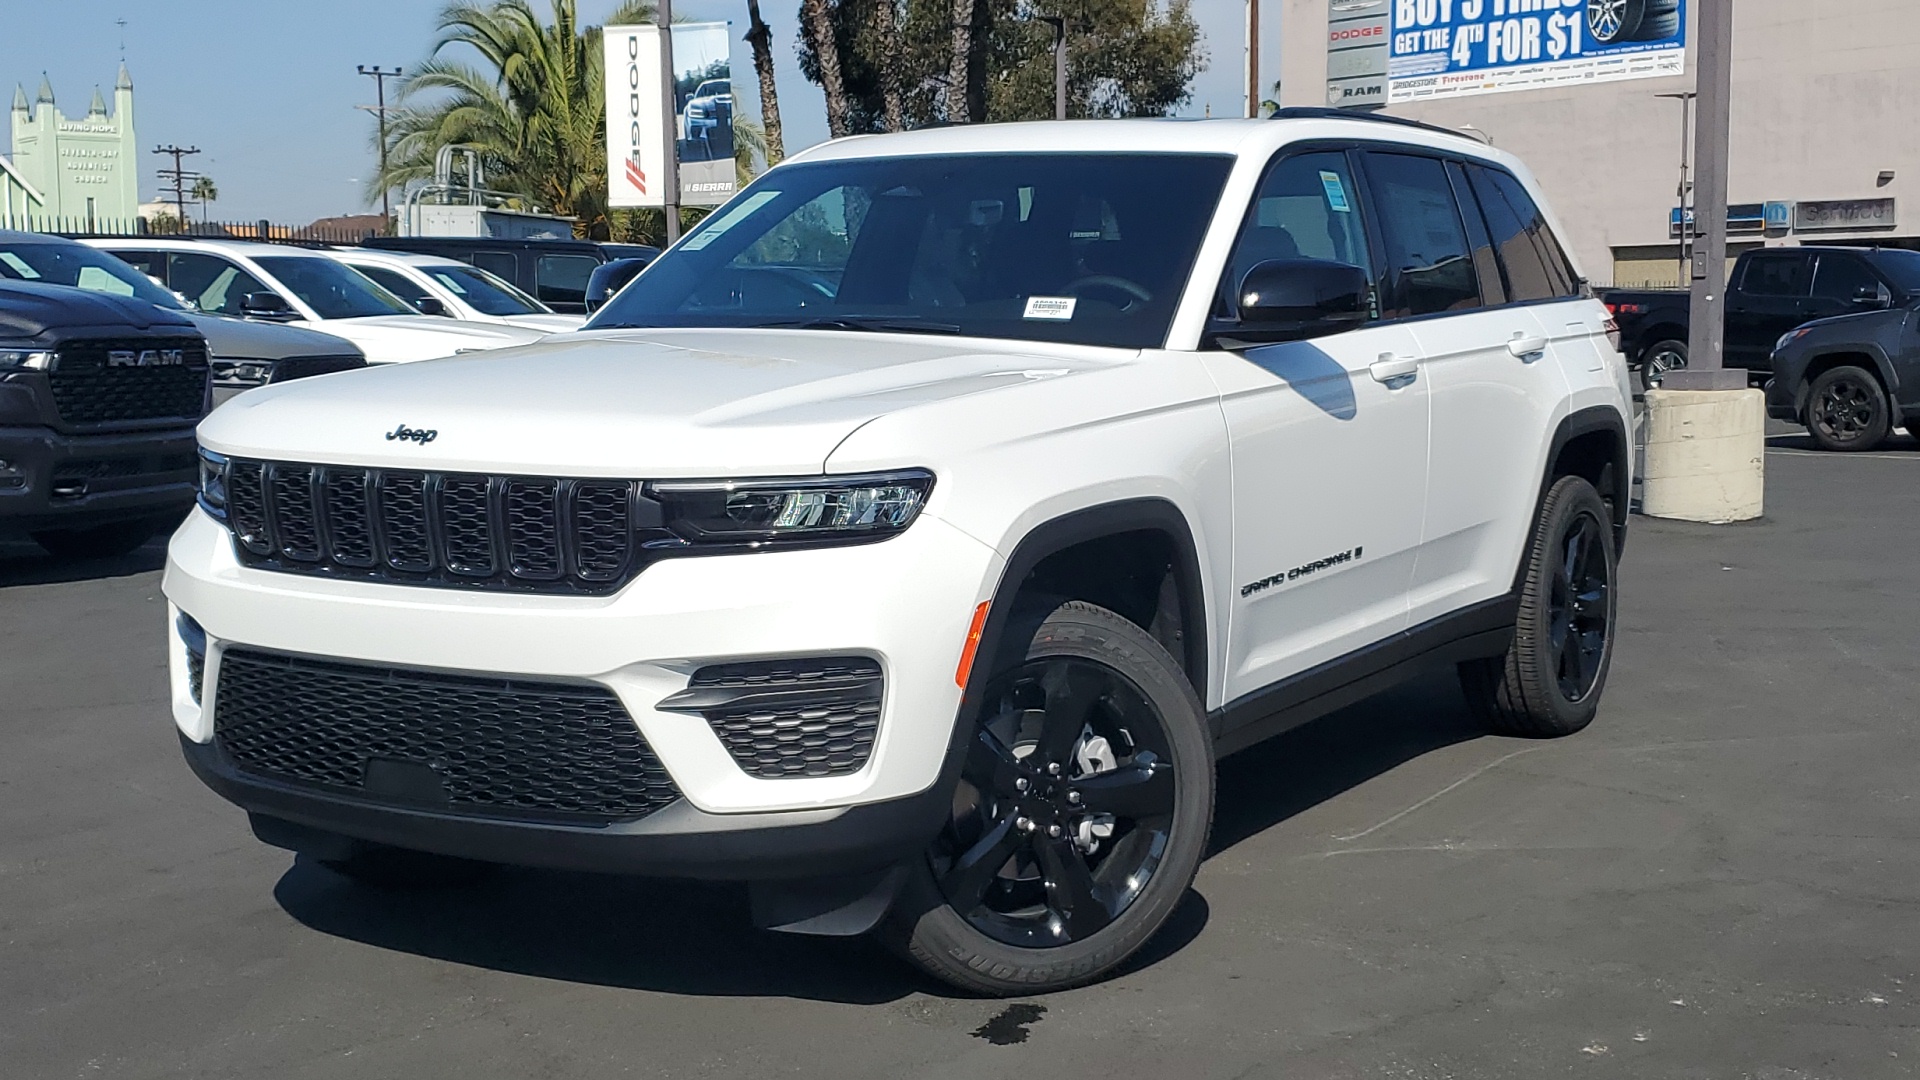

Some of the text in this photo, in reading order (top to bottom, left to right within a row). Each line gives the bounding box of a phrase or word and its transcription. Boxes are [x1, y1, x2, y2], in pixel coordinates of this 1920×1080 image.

[1330, 26, 1383, 41] DODGE
[1394, 31, 1422, 55] GET
[1423, 27, 1450, 51] THE
[1487, 17, 1542, 64] FOR
[1546, 10, 1583, 60] $1
[1442, 73, 1486, 85] Firestone
[1343, 85, 1381, 97] RAM
[628, 35, 642, 173] DODGE
[59, 123, 117, 134] LIVING HOPE
[692, 182, 733, 192] SIERRA
[107, 349, 183, 366] RAM
[385, 424, 438, 446] Jeep
[1241, 549, 1352, 598] GRAND CHEROKEE
